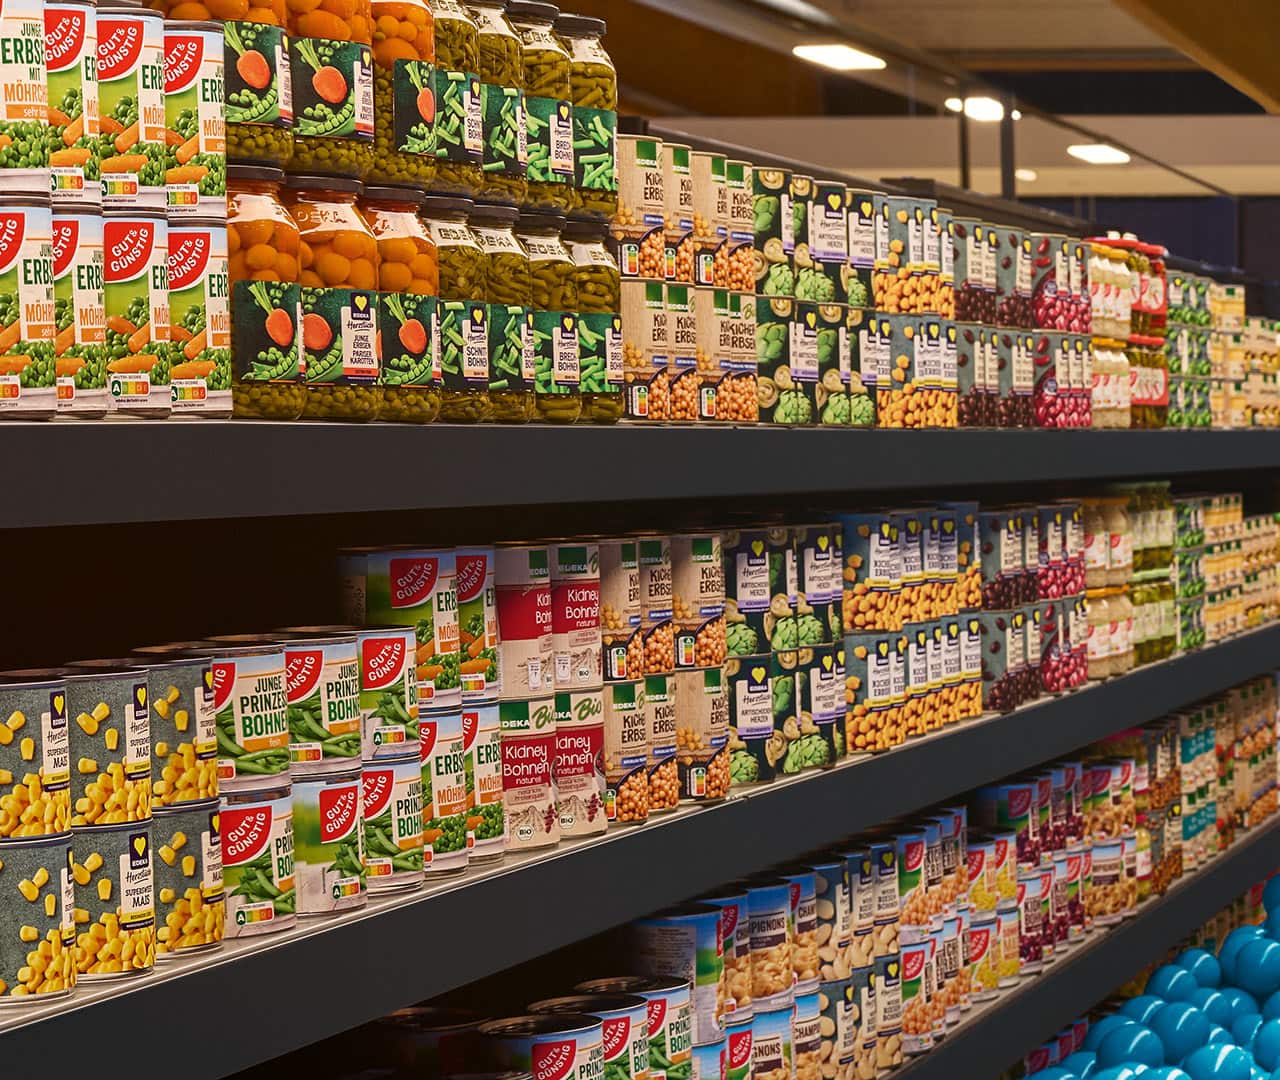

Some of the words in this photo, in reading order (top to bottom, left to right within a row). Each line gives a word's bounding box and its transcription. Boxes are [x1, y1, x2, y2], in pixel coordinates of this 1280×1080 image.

[45, 16, 81, 61] GÜNSTIG
[46, 17, 70, 44] GUT&
[98, 27, 125, 55] GUT&
[98, 26, 138, 71] GÜNSTIG
[29, 67, 40, 81] MIT
[111, 228, 149, 273] GÜNSTIG
[112, 229, 137, 258] GUT&
[368, 641, 402, 681] GÜNSTIG
[370, 645, 392, 669] GUT&
[255, 676, 282, 693] JUNGE
[505, 744, 547, 763] Kidney
[503, 761, 549, 777] Bohnen
[326, 791, 355, 833] GÜNSTIG
[327, 794, 347, 819] GUT&
[227, 812, 266, 857] GÜNSTIG
[228, 815, 254, 842] GUT&
[538, 1048, 560, 1069] GUT&
[538, 1044, 570, 1080] GÜNSTIG
